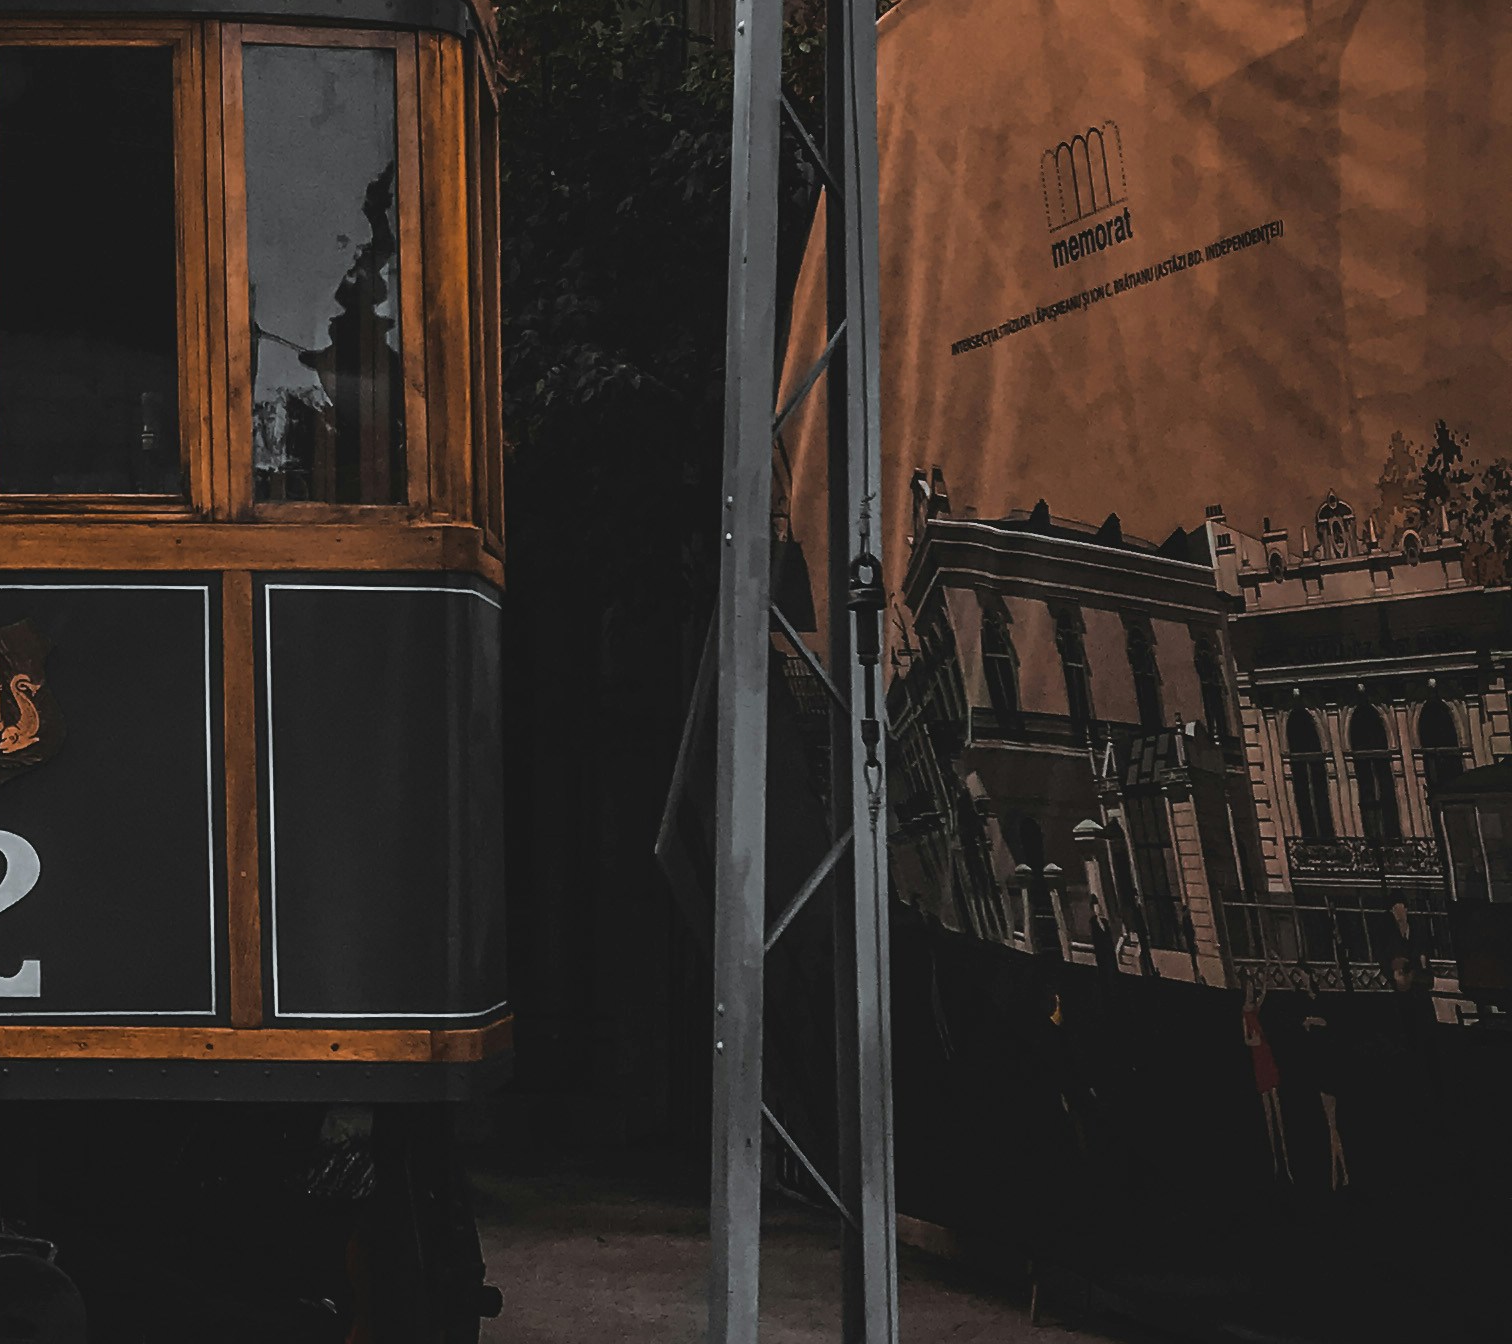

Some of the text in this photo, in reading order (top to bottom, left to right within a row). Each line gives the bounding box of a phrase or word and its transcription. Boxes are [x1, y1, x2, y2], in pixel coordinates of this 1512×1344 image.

[1052, 207, 1133, 268] memorat
[1153, 253, 1186, 280] (ASTĂZI
[1187, 250, 1204, 267] BD.
[1205, 219, 1284, 261] INDEPENDENȚEI)
